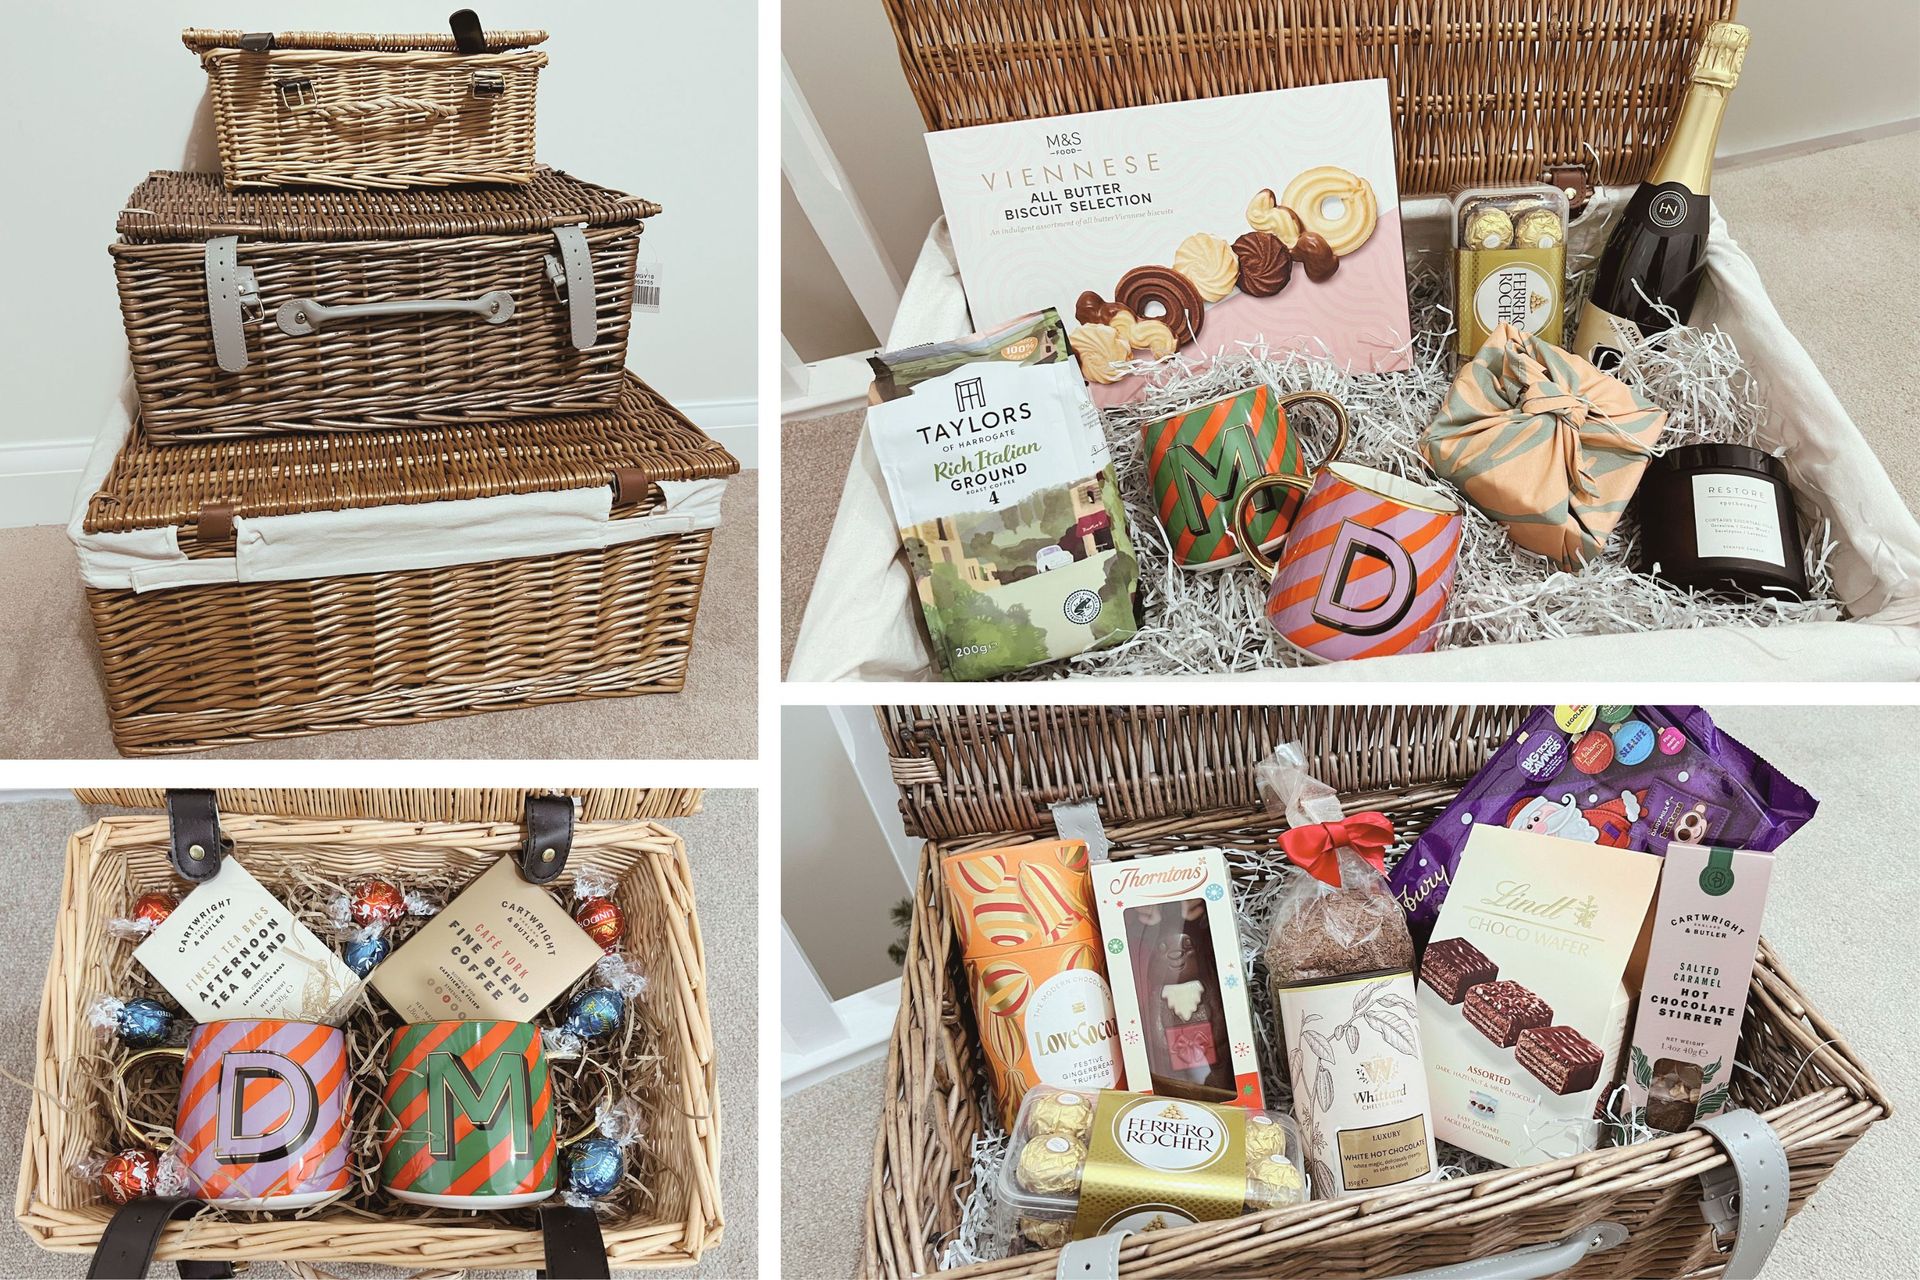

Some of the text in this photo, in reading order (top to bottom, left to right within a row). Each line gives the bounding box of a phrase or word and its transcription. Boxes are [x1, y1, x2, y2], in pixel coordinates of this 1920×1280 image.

[1046, 131, 1082, 149] M&S
[981, 152, 1160, 191] VIENNESE
[1031, 182, 1121, 203] ALL BUTTER
[1004, 192, 1152, 220] BISCUIT SELECTION
[1002, 224, 1035, 235] indulgent
[1036, 219, 1075, 231] assortment
[1082, 215, 1092, 225] all
[1093, 213, 1114, 223] butter
[1114, 210, 1146, 222] Viennese
[1147, 207, 1175, 217] biscuits
[1497, 273, 1513, 325] ROCHE
[916, 403, 1032, 445] TAYLORS
[942, 428, 1016, 453] OF HARROGATE
[934, 440, 1042, 482] Rich Italian
[950, 462, 1028, 492] GROUND
[966, 479, 1016, 496] ROAST COFFEE
[1166, 424, 1276, 537] M
[989, 491, 1000, 505] 4
[1708, 486, 1765, 500] RESTORE
[1311, 516, 1418, 637] D
[955, 644, 988, 658] 200g
[1565, 705, 1588, 727] LEGOLAN
[1521, 752, 1540, 771] BIG
[1536, 735, 1554, 754] TICKET
[1530, 739, 1561, 776] SAVINGS
[1619, 739, 1634, 758] SEA
[1659, 802, 1684, 839] buttons
[1110, 865, 1208, 896] Thorntons
[1480, 880, 1576, 921] Lindt
[178, 898, 231, 953] CARTWRIGHT
[199, 914, 225, 940] BUTLER
[501, 900, 556, 956] CARTWRIGHT
[513, 922, 540, 950] BUTLER
[1468, 915, 1590, 957] CHOCO WAFER
[1670, 914, 1745, 936] CARTWRIGHT
[1694, 929, 1727, 939] BUTLER
[185, 905, 269, 993] FINEST TEA BAGS
[198, 917, 280, 1002] AFTERNOON
[448, 919, 530, 1004] FINE BLEND
[474, 922, 529, 979] CAFÉ YORK
[211, 932, 287, 1010] TEA BLEND
[451, 945, 504, 1001] COFFEE
[1673, 972, 1722, 988] CARAMEL
[1680, 962, 1720, 976] SALTED
[249, 983, 264, 999] FINEST
[260, 980, 287, 1008] NET WEIGHT
[1041, 979, 1071, 1001] MODERN
[1681, 987, 1710, 1000] HOT
[1650, 994, 1736, 1017] CHOCOLATE
[1658, 1008, 1723, 1027] STIRRER
[1680, 1038, 1705, 1047] WEIGHT
[1062, 1060, 1115, 1080] GINGERBREAD
[1074, 1056, 1103, 1068] FESTIVE
[1073, 1070, 1110, 1085] TRUFFLES
[1453, 1071, 1483, 1085] HAZELNUT
[1490, 1084, 1504, 1093] MILK
[1505, 1088, 1536, 1104] CHOCOLA
[1467, 1065, 1511, 1086] ASSORTED
[426, 1050, 532, 1162] M
[1354, 1084, 1407, 1104] Whittard
[215, 1050, 319, 1164] D
[1127, 1117, 1214, 1139] FERRERO
[1443, 1115, 1462, 1128] FACILE
[1481, 1123, 1500, 1134] SHARE
[1126, 1130, 1213, 1153] ROCHER
[1372, 1130, 1401, 1141] LUXURY
[1344, 1139, 1425, 1162] WHITE HOT CHOCOLATE
